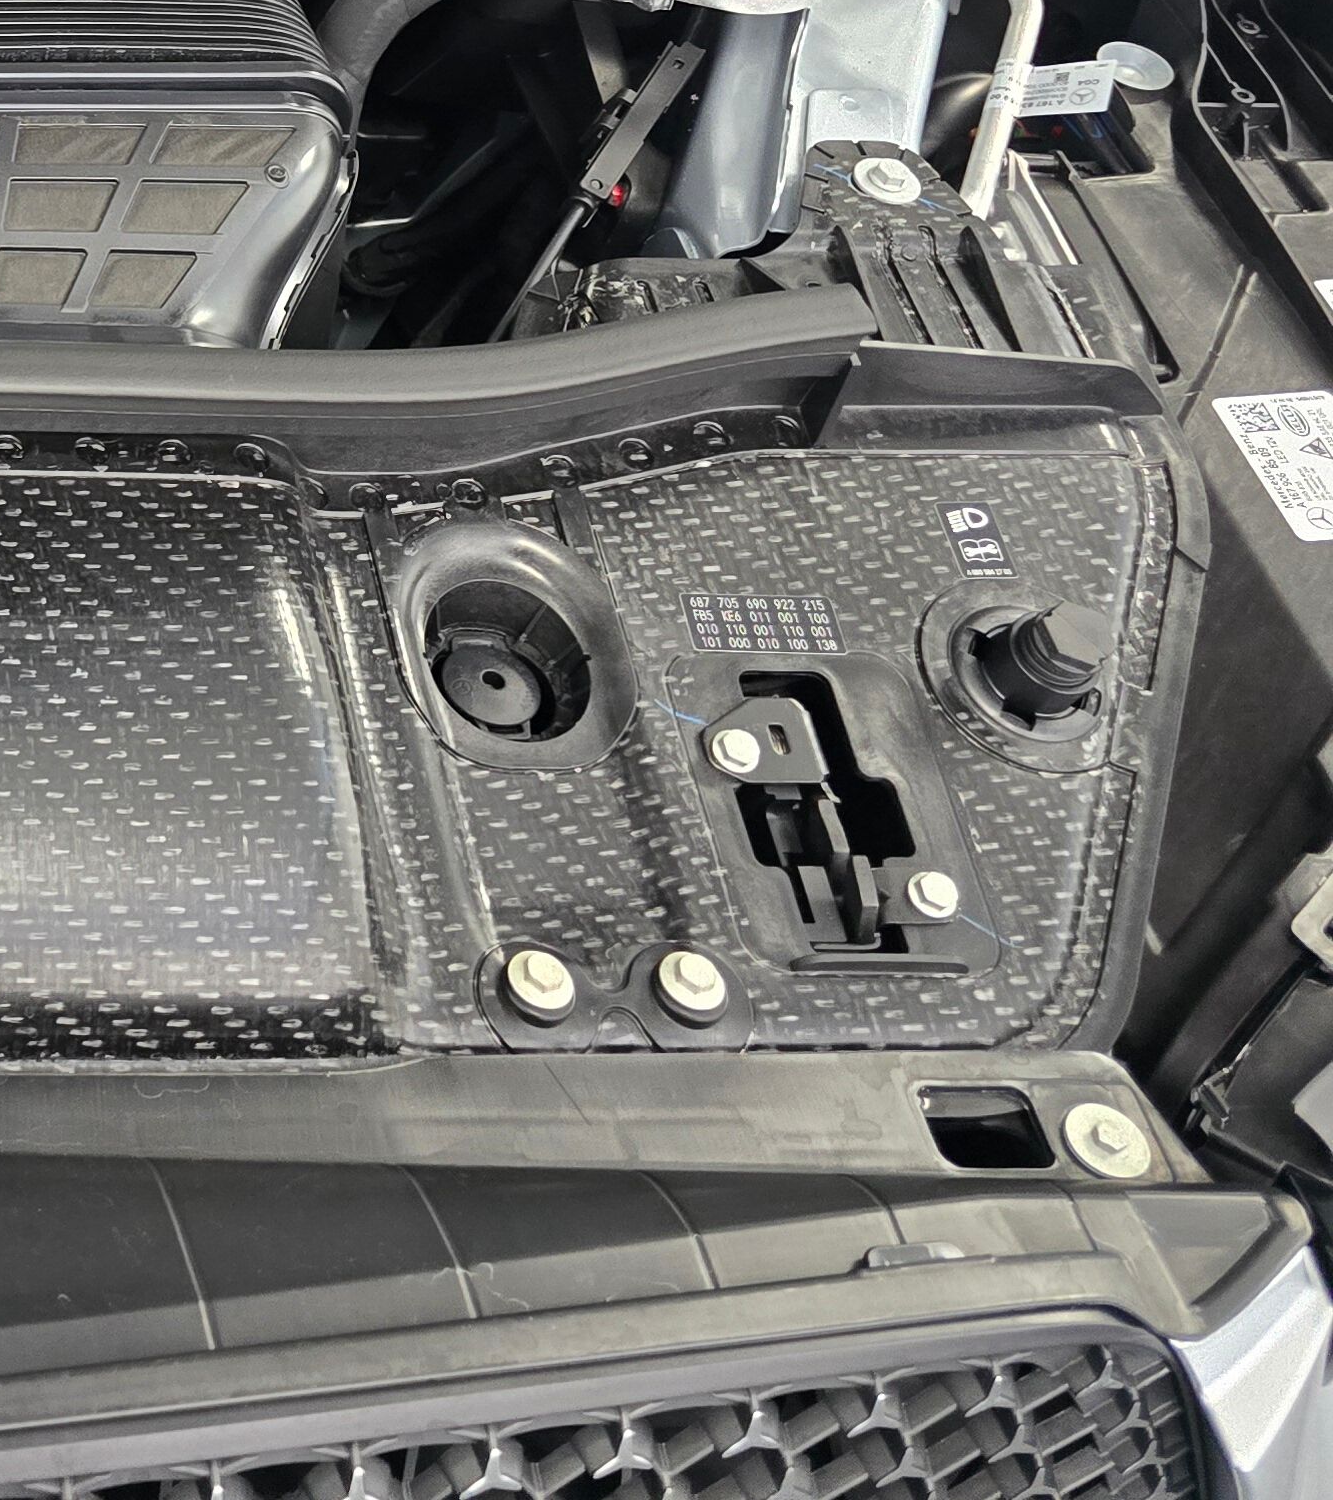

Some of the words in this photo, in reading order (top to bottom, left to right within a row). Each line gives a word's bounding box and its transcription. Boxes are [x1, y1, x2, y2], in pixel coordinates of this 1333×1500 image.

[1239, 434, 1259, 455] Benz
[1261, 464, 1294, 509] Mercedes
[689, 596, 709, 608] 687
[717, 597, 739, 609] 705
[746, 598, 767, 609] 690
[773, 599, 796, 610] 922
[802, 600, 825, 611] 215
[693, 609, 714, 621] FB5
[720, 610, 742, 622] KE6
[749, 611, 771, 622] 011
[778, 612, 799, 623] 001
[807, 613, 829, 624] 100
[696, 623, 718, 634] 010
[726, 624, 747, 635] 110
[753, 625, 775, 636] 001
[783, 625, 804, 637] 110
[811, 626, 833, 637] 001
[701, 636, 722, 648] 101
[728, 637, 750, 648] 000
[757, 638, 780, 649] 010
[787, 638, 808, 650] 100
[815, 639, 837, 651] 138
